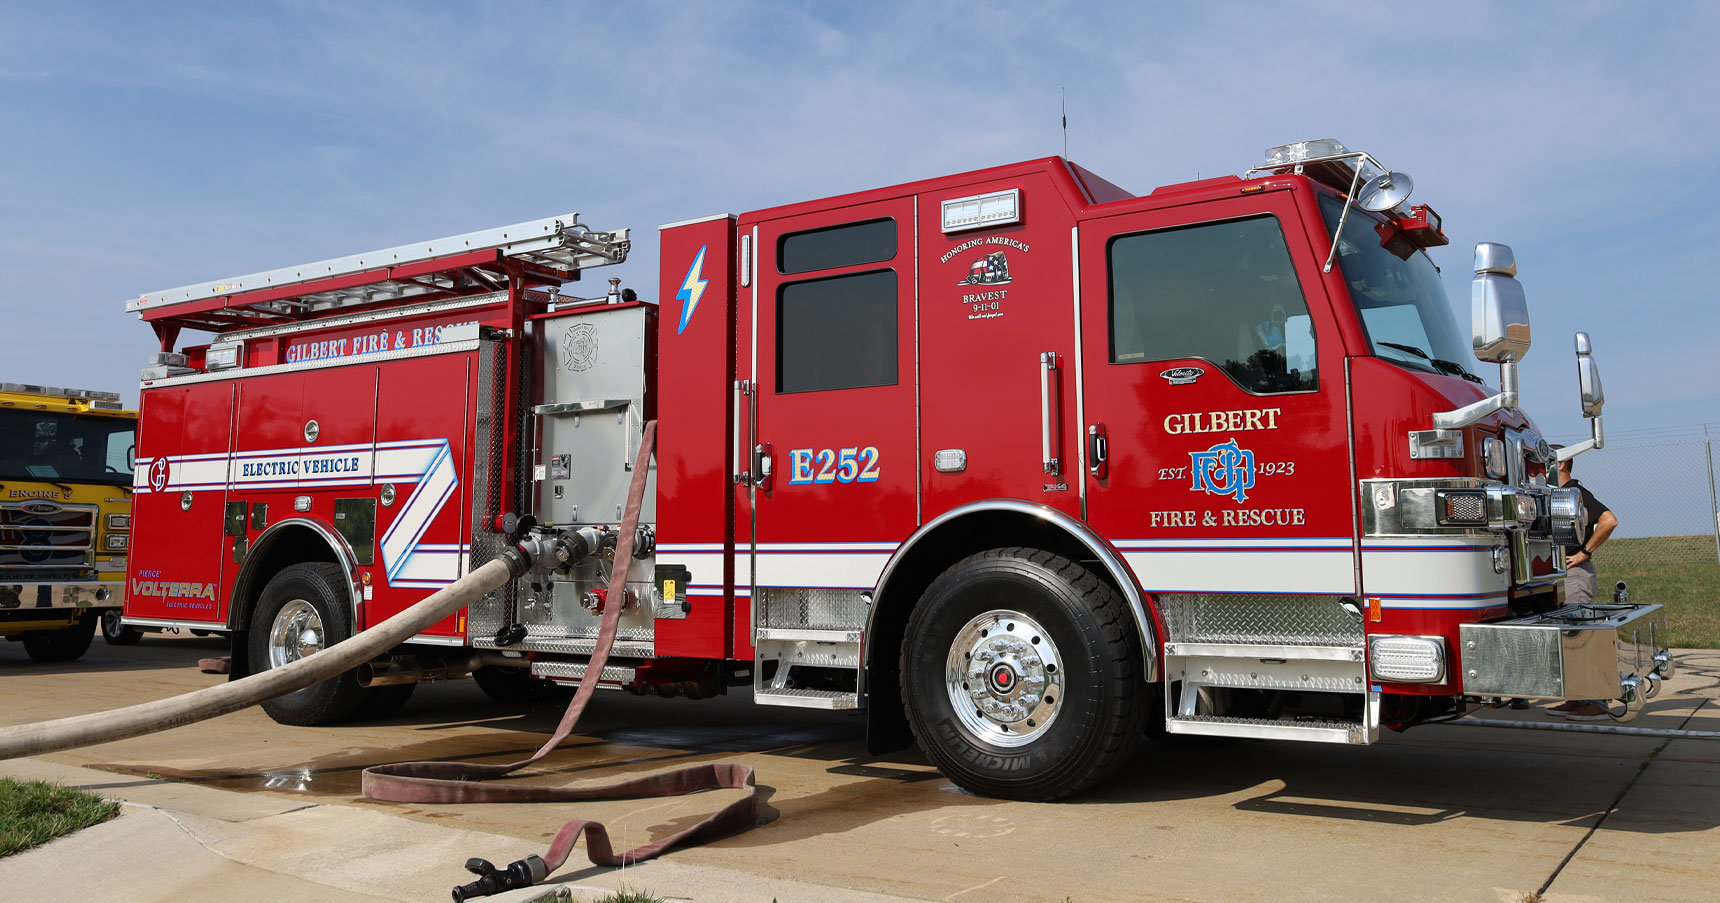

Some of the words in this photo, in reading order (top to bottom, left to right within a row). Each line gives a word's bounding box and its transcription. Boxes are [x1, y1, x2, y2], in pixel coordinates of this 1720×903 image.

[940, 238, 984, 264] HONORING
[985, 236, 1030, 253] AMERICA'S
[963, 290, 1007, 304] BRAVEST
[972, 302, 999, 312] 9-11-01
[286, 338, 347, 364] GILBERT
[352, 331, 389, 356] FIRE
[394, 330, 407, 350] &
[412, 321, 479, 349] RES
[1163, 407, 1281, 435] GILBERT
[242, 460, 299, 477] ELECTRIC
[303, 457, 359, 474] VEHICLE
[788, 446, 881, 485] E252
[1258, 461, 1295, 476] 1923
[9, 489, 59, 499] ENGINE
[64, 491, 71, 499] 8
[1150, 510, 1197, 528] FIRE
[1202, 510, 1218, 527] &
[1222, 508, 1305, 526] RESCUE
[138, 570, 161, 578] PIERCE
[132, 578, 216, 602] VOLTERRA
[936, 721, 1031, 771] MICHELIN
